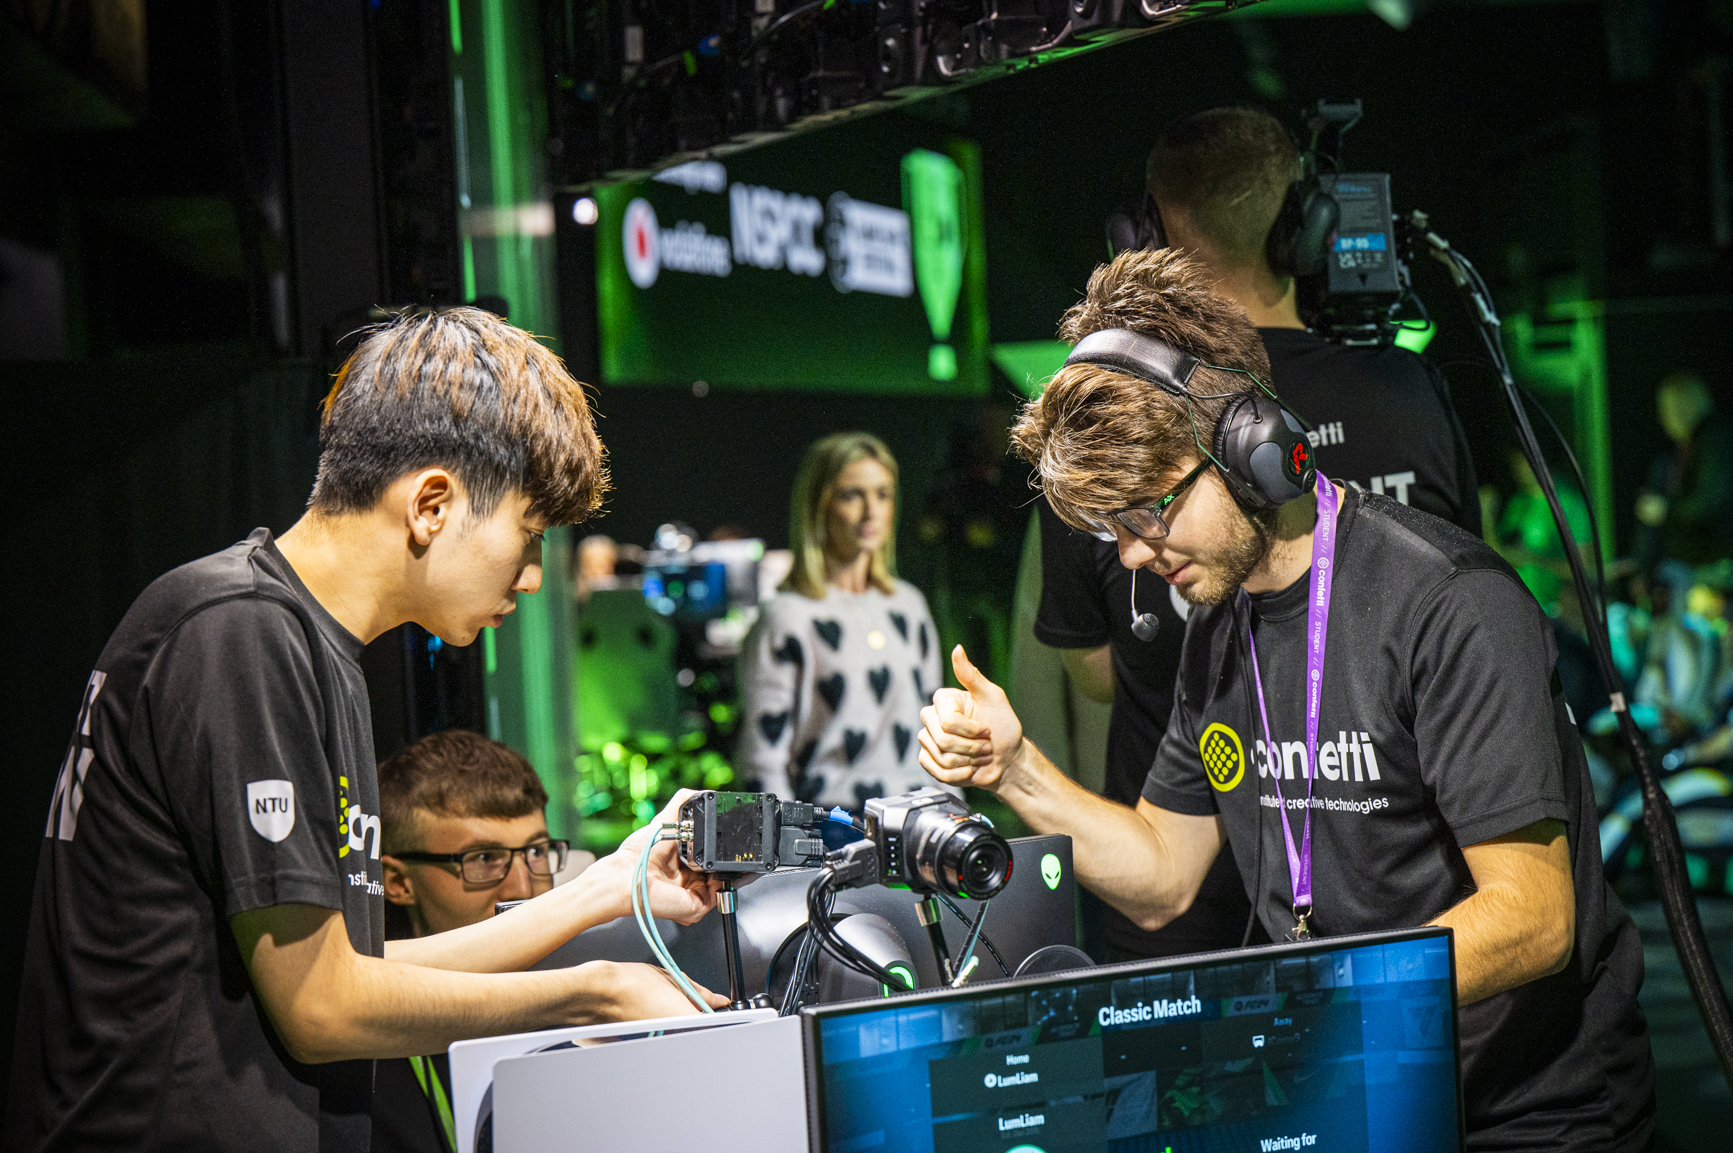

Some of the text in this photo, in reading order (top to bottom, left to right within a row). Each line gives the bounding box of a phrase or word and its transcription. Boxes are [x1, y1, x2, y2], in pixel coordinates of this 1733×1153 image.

[1321, 509, 1331, 542] STUDENT
[1316, 569, 1326, 606] confetti
[1313, 621, 1322, 655] STUDENT
[1252, 731, 1381, 781] conetti
[255, 797, 289, 814] NTU
[1325, 797, 1389, 814] technologies
[1098, 995, 1202, 1026] Classic Match
[1006, 1054, 1030, 1066] Home
[997, 1071, 1039, 1087] LumLiam
[998, 1113, 1045, 1131] LumLiam
[1260, 1133, 1317, 1153] Waiting for
